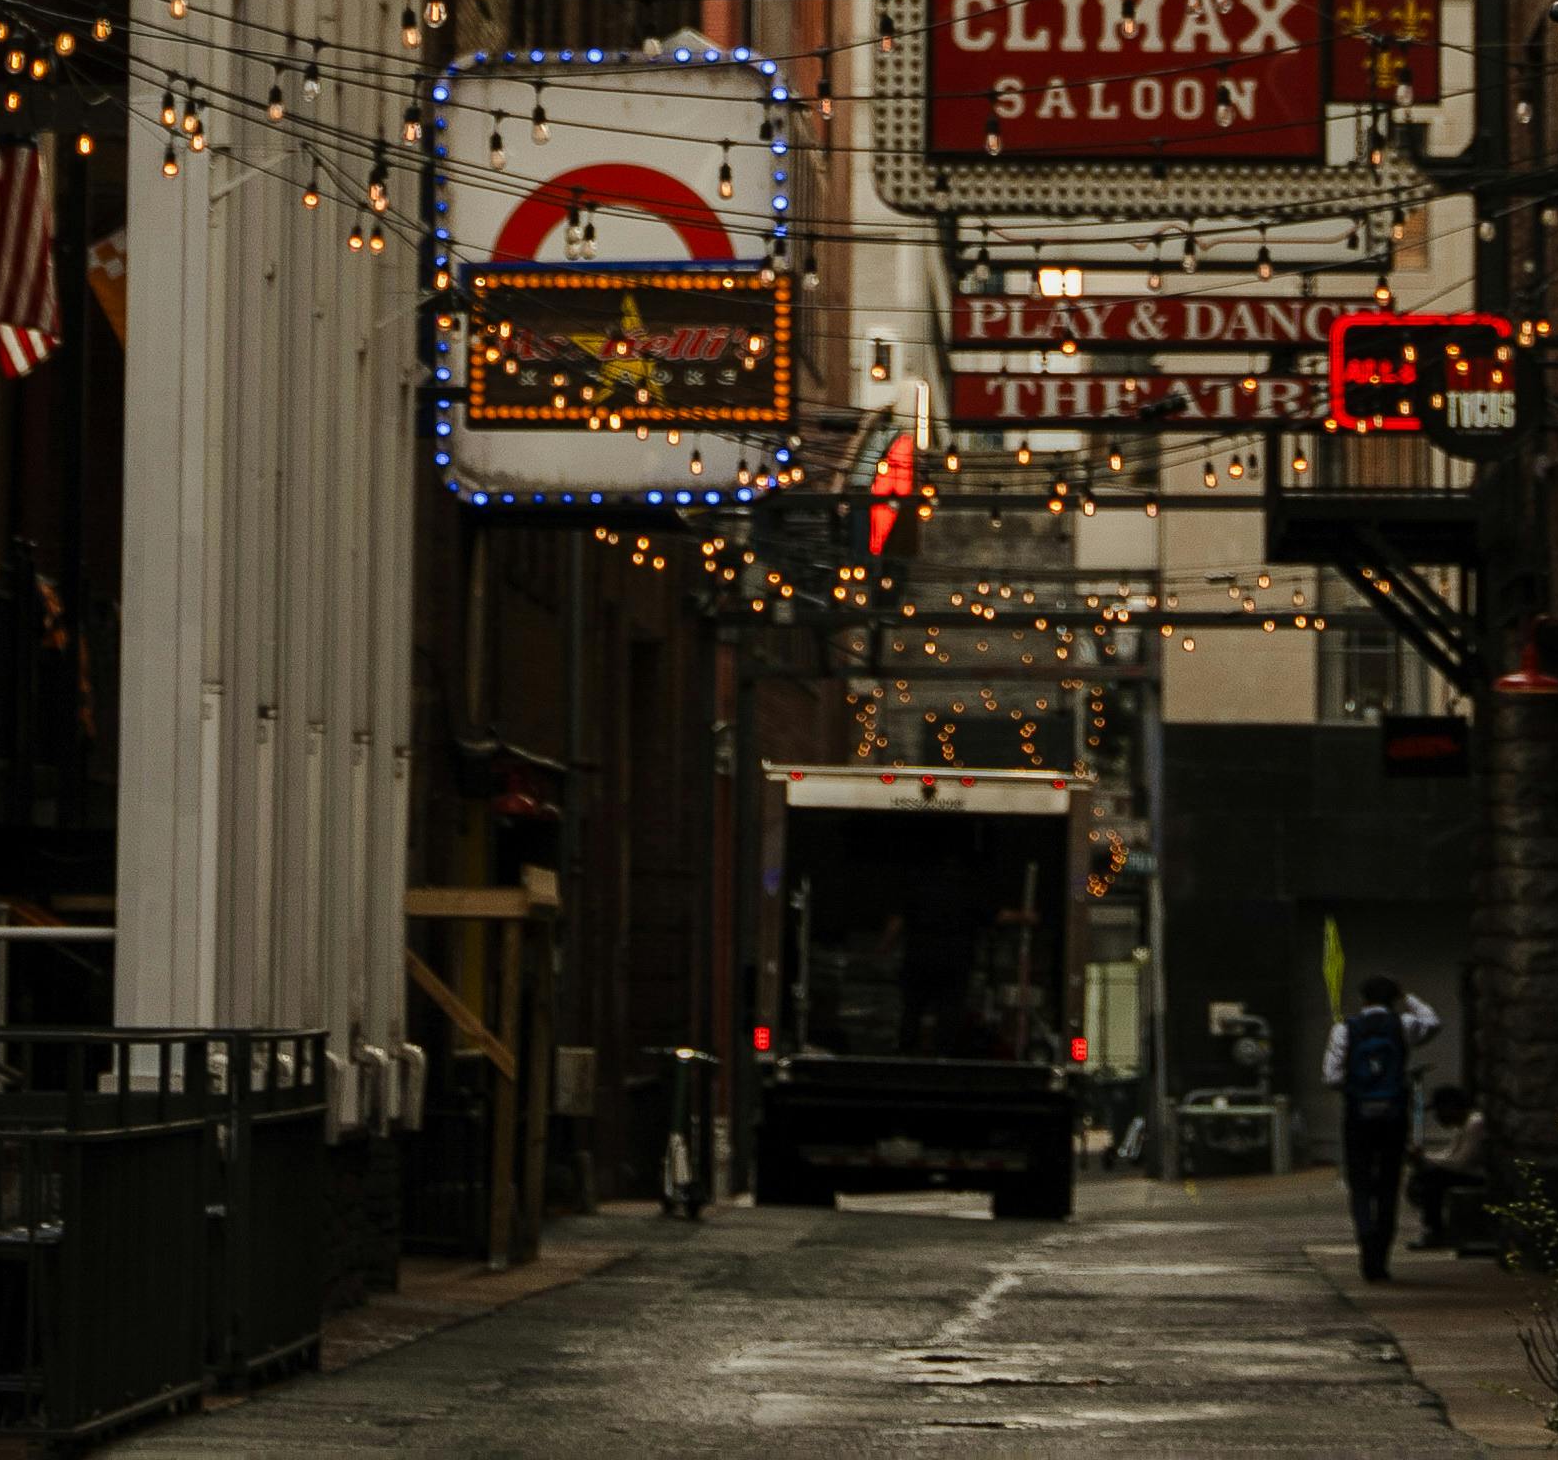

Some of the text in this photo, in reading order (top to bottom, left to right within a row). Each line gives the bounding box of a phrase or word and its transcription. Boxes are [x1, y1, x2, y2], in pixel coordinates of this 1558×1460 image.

[991, 75, 1259, 122] SALOON
[965, 298, 1383, 342] PLAY & DANC
